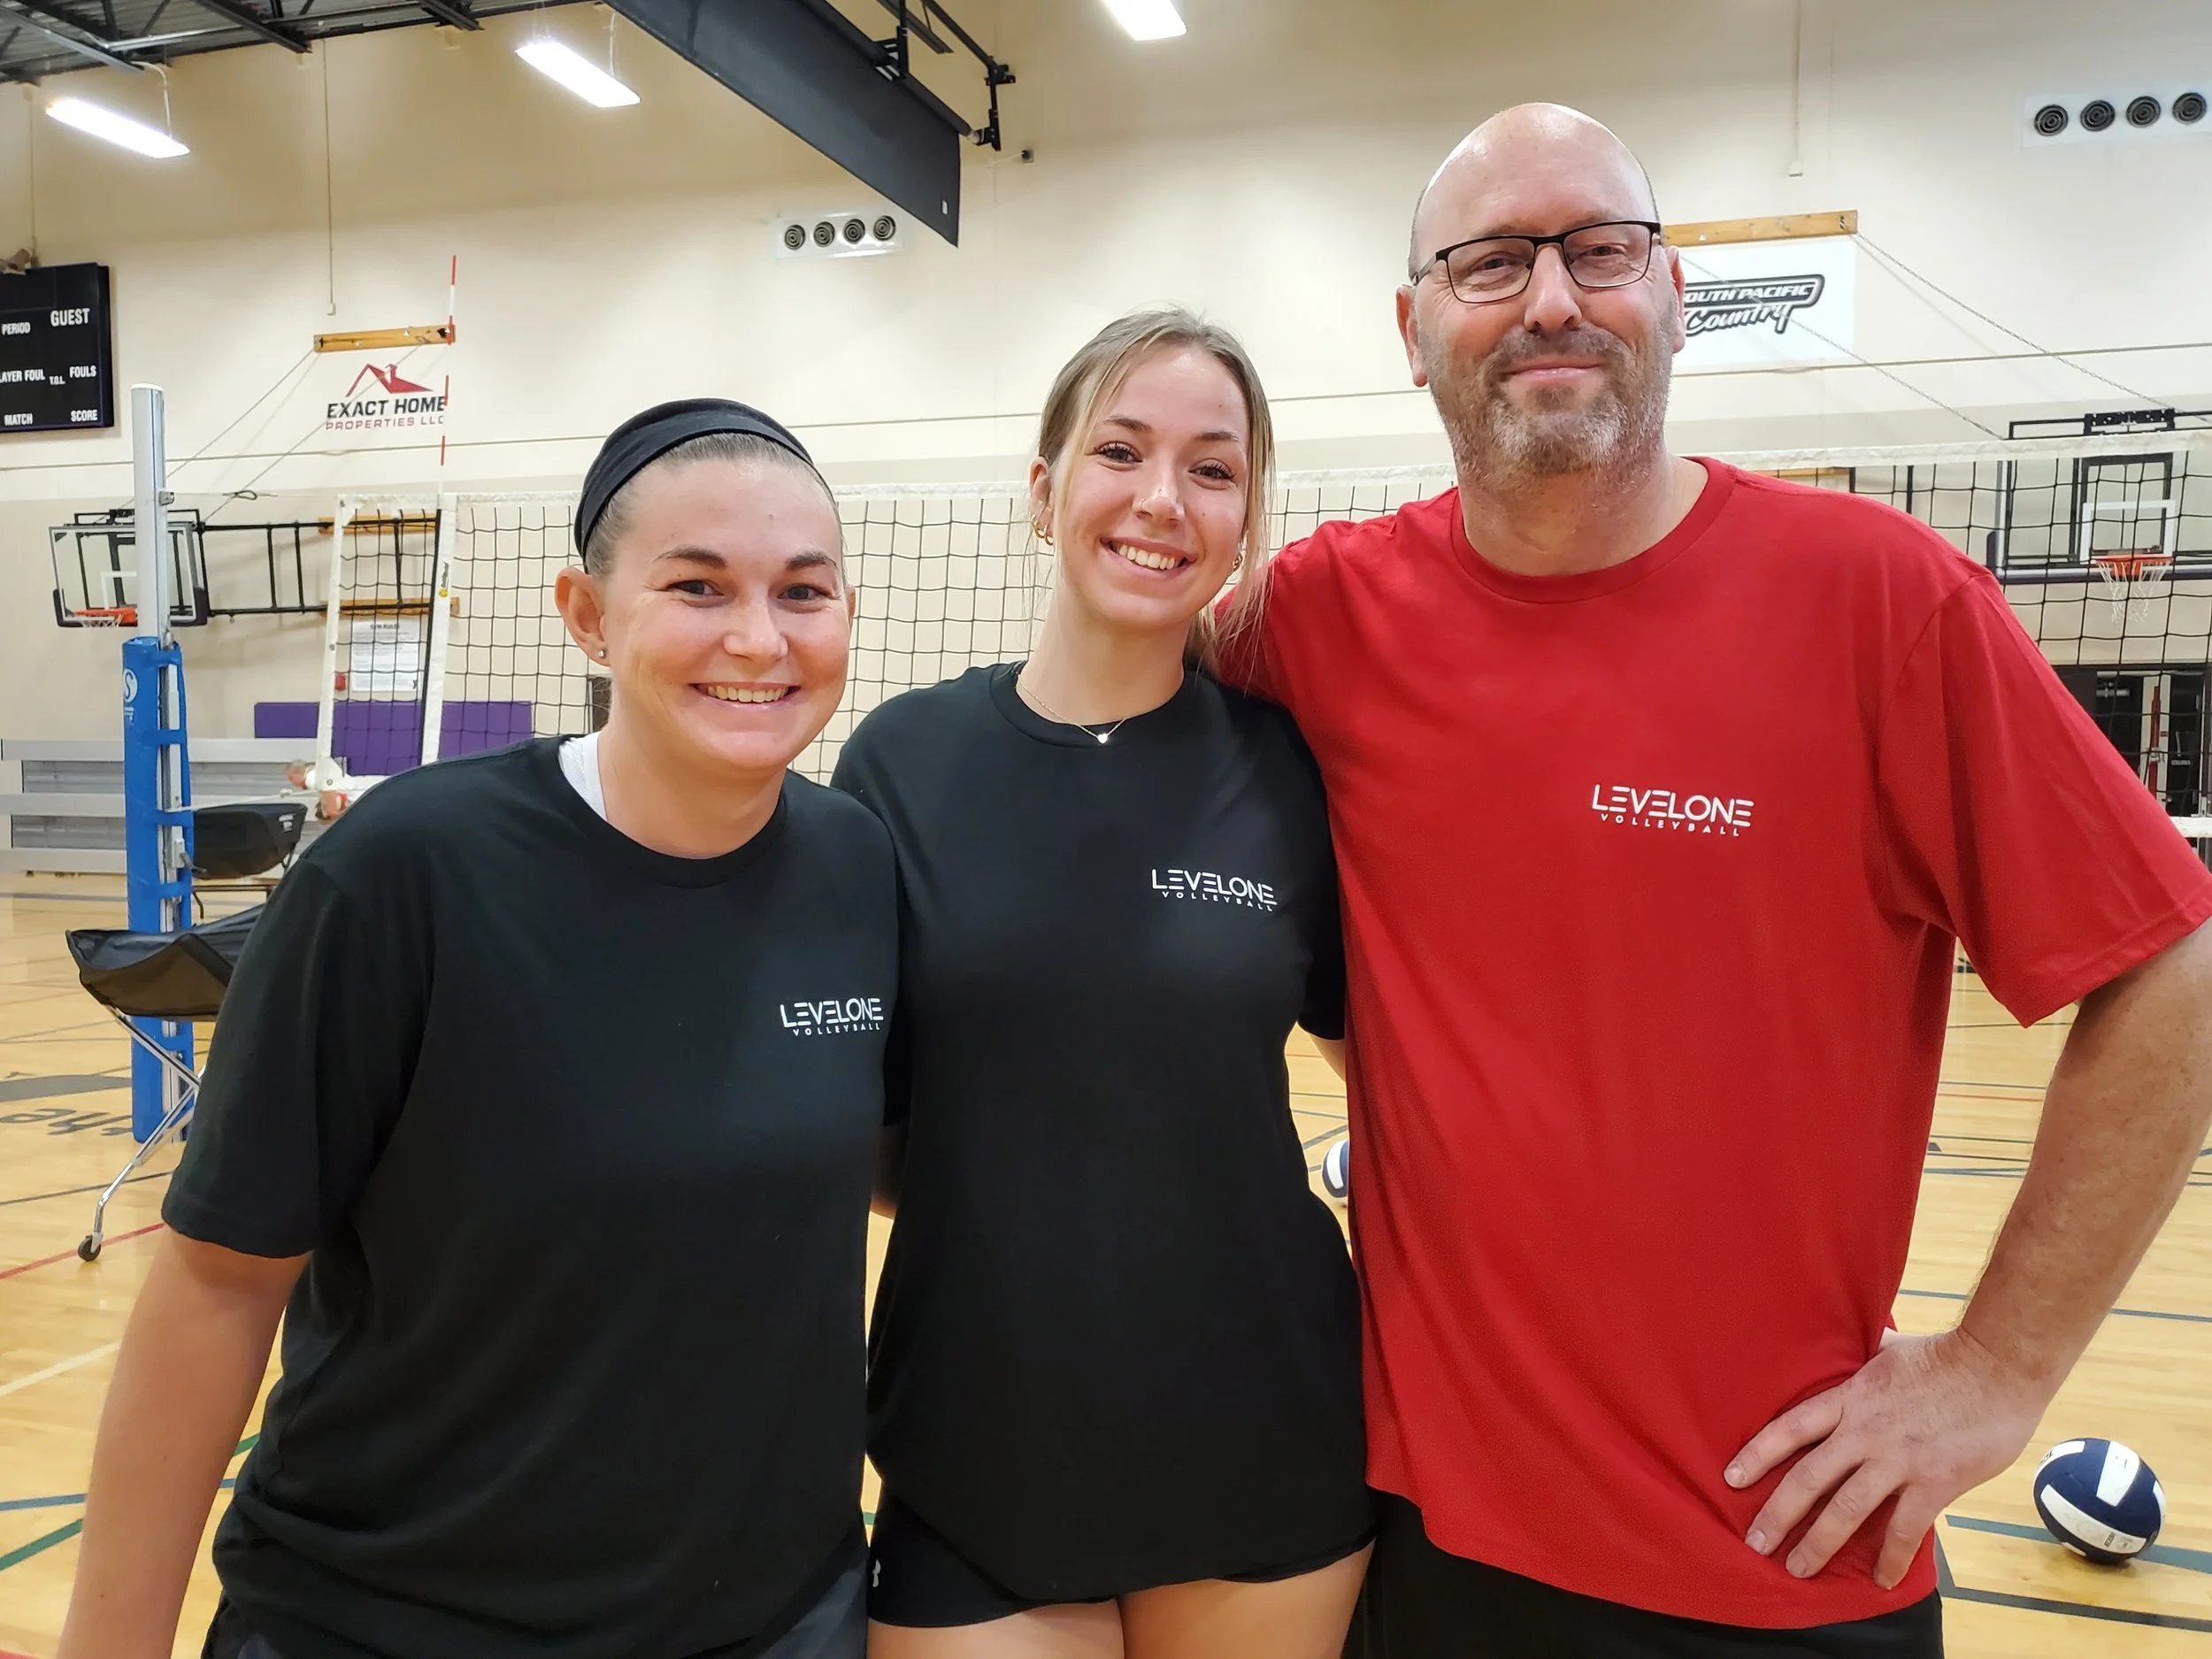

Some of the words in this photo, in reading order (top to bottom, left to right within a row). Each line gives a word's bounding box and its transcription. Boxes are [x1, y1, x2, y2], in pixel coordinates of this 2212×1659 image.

[1685, 289, 1736, 303] OUTH
[1737, 284, 1816, 300] PACIFIC
[50, 308, 90, 327] GUEST
[2, 322, 31, 335] PERIOD
[24, 368, 46, 381] FOUL
[70, 365, 97, 379] FOULS
[71, 410, 98, 422] SCORE
[326, 400, 388, 419] EXACT
[394, 396, 446, 414] HOME
[4, 413, 34, 426] MATCH
[326, 417, 415, 430] PROPERTIES
[1592, 784, 1755, 827] LEVELONE
[1601, 813, 1740, 836] VOLLEYBALL
[1151, 869, 1278, 905] LEVELONE
[1162, 891, 1272, 911] VOLLEYBALL
[780, 997, 884, 1028] LEVELONE
[792, 1023, 880, 1037] VOLLEYBALL
